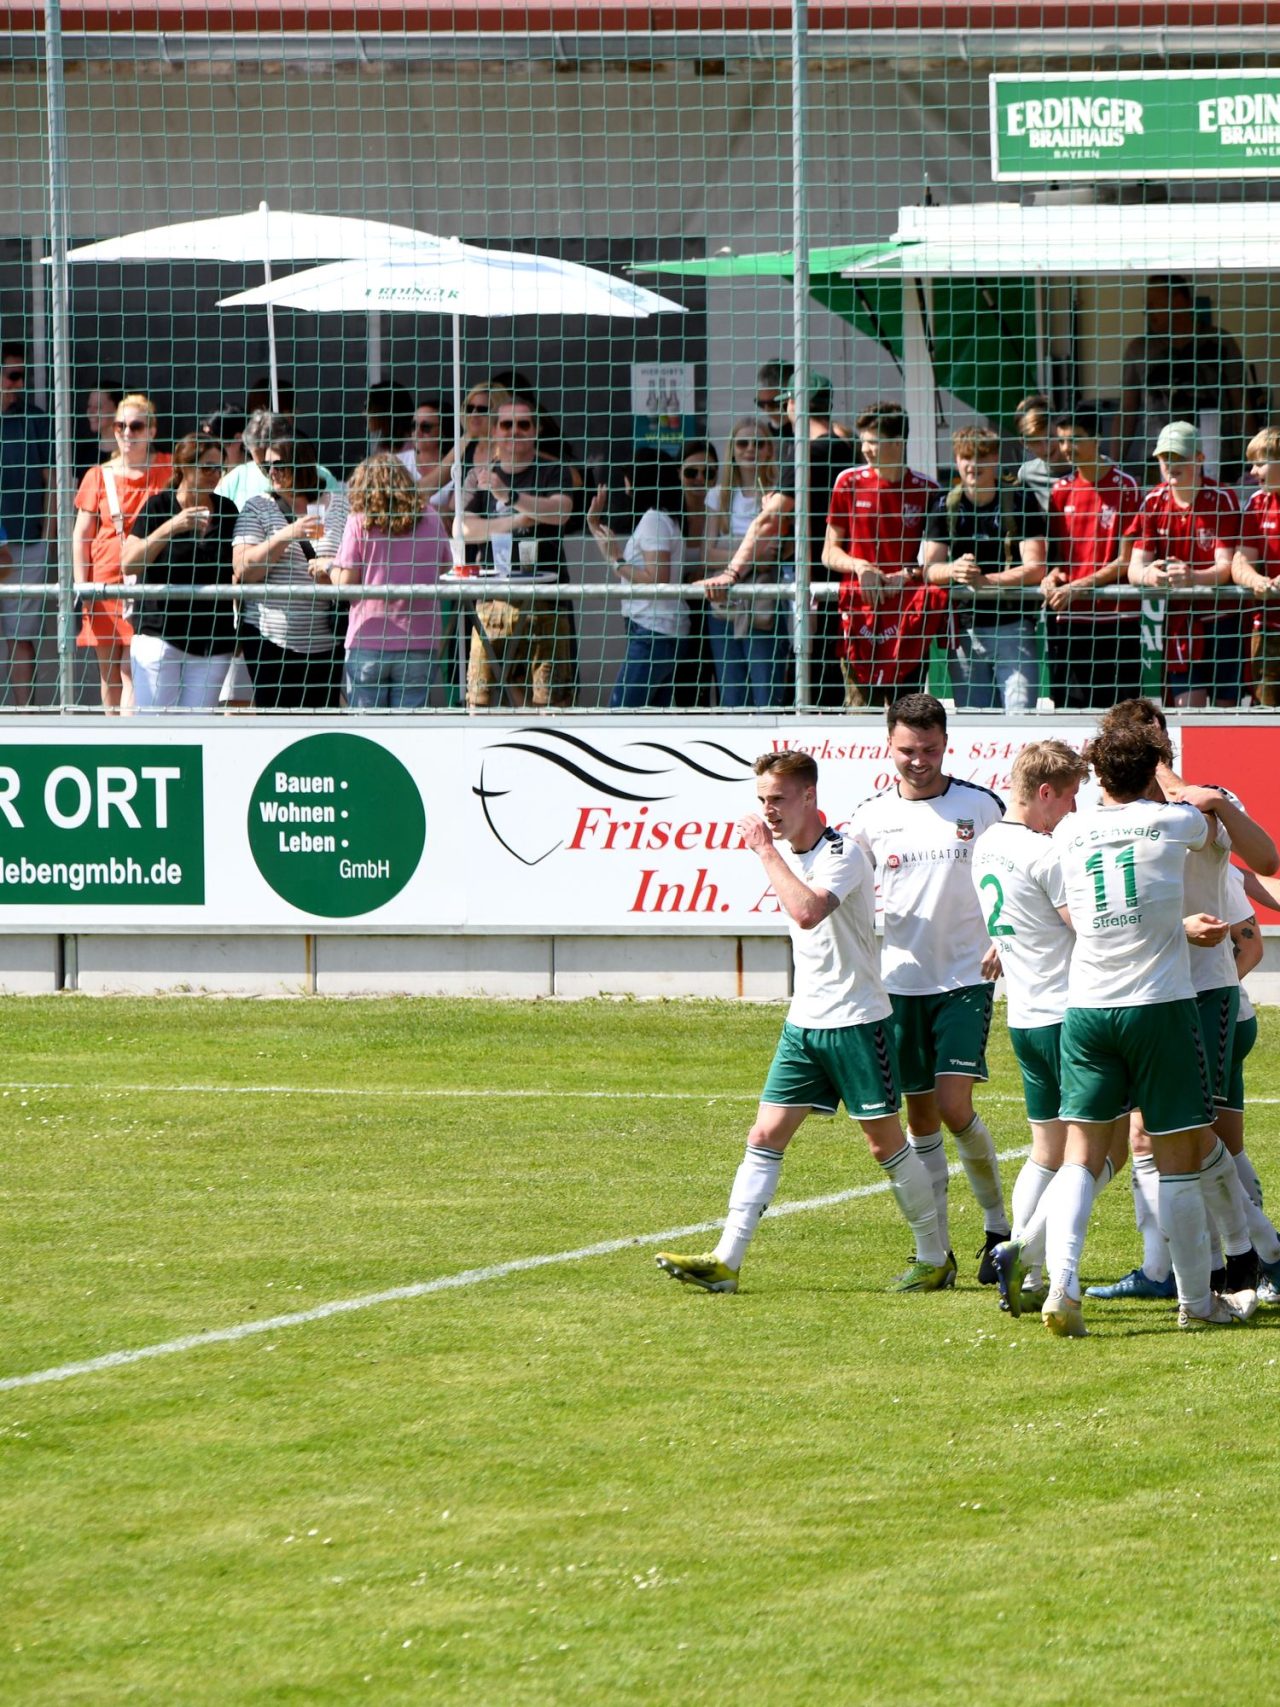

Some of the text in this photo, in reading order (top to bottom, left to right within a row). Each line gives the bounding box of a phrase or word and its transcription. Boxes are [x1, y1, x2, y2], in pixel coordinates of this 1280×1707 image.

[1007, 97, 1144, 136] ERDINGER
[1029, 128, 1125, 148] BRAUHAUS
[1053, 149, 1101, 159] BAYERN
[275, 772, 335, 793] Bauen
[44, 765, 181, 829] ORT
[260, 802, 335, 823] Wohnen
[279, 832, 335, 853] Leben
[902, 848, 968, 862] NAVIGATOR
[339, 859, 390, 880] GmbH
[1085, 846, 1138, 912] 11
[627, 868, 730, 912] Inh.
[980, 874, 1016, 936] 2
[1092, 914, 1143, 929] Straßer
